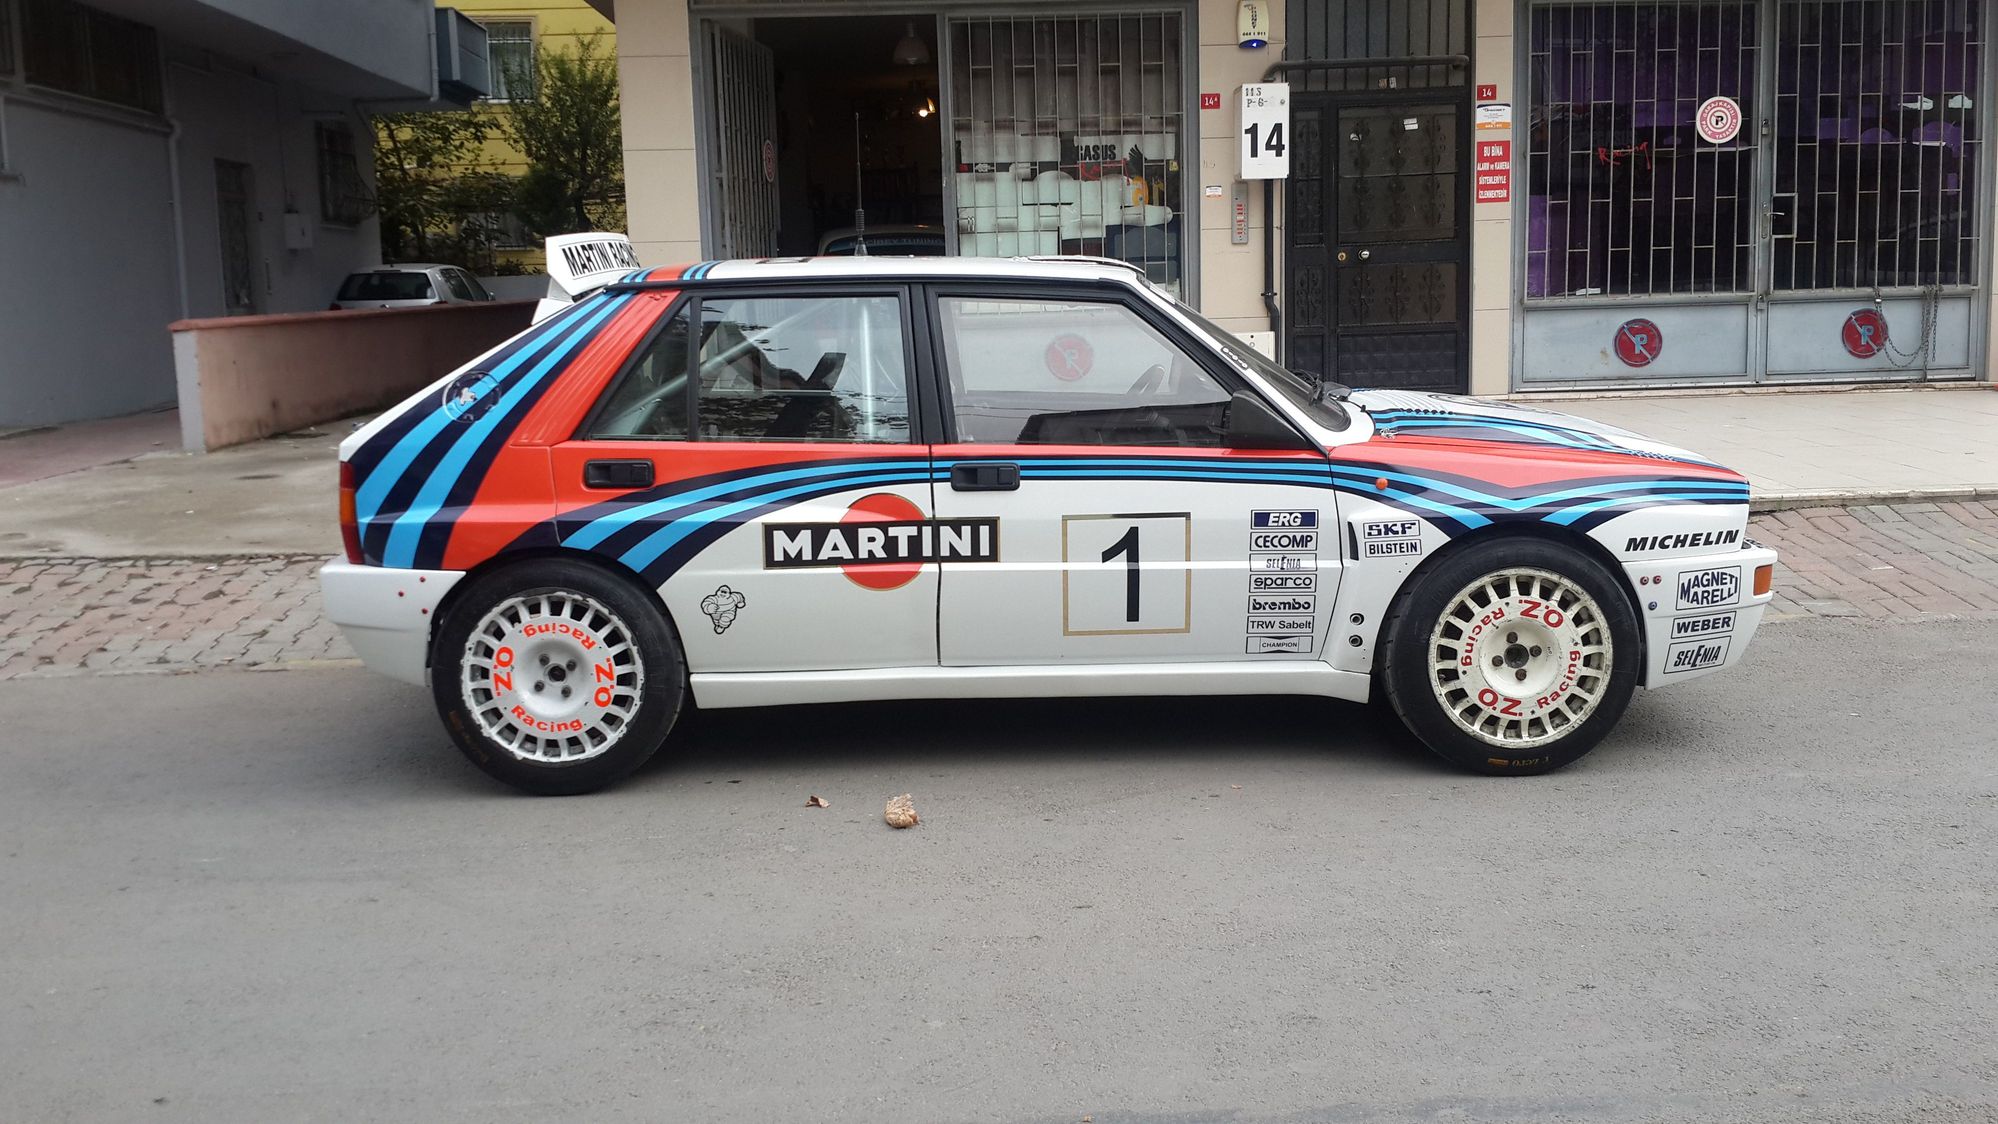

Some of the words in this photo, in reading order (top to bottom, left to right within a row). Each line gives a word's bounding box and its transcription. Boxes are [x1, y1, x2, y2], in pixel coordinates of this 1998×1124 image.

[1482, 88, 1492, 97] 14
[1244, 122, 1286, 158] 14
[562, 242, 615, 277] MARTINI
[1267, 513, 1302, 527] ERG
[1367, 522, 1416, 537] SKF
[772, 525, 991, 562] MARTINI
[1254, 534, 1314, 548] CECOMP
[1369, 541, 1418, 555] BILSTEIN
[1624, 529, 1740, 552] MICHELIN
[1101, 526, 1140, 623] 1
[1253, 576, 1313, 590] sparco
[1680, 571, 1738, 596] MAGNETI
[1252, 598, 1311, 611] brembo
[1680, 582, 1738, 605] MARELLI
[1249, 620, 1275, 629] TRW
[1278, 619, 1312, 629] Sabelt
[1676, 616, 1732, 634] WEBER
[523, 623, 597, 650] Racing
[1460, 607, 1505, 667] Racing
[1673, 644, 1722, 668] SELENIA
[1536, 650, 1581, 710] Racing
[511, 704, 583, 733] Racing
